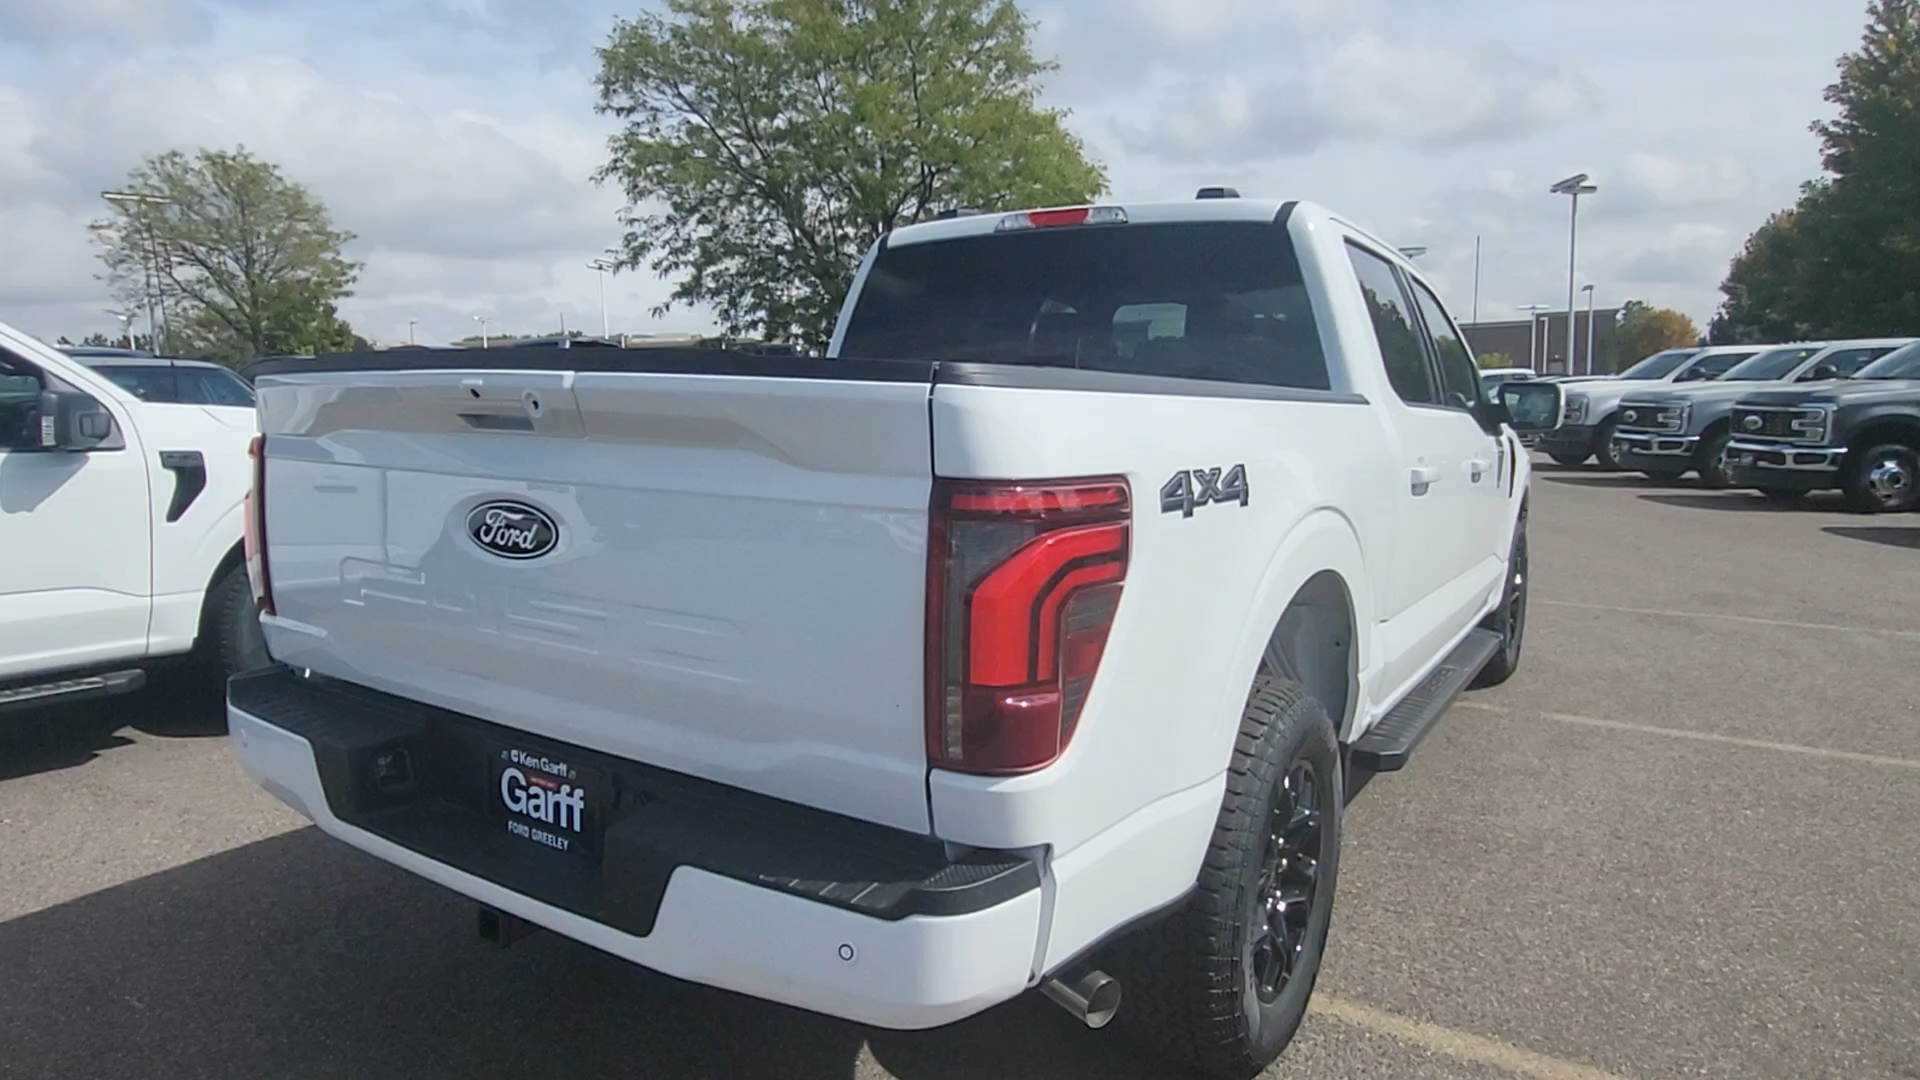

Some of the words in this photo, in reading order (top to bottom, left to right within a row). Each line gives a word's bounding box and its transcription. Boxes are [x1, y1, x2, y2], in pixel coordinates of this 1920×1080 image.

[479, 508, 540, 549] Ford
[540, 757, 567, 777] Garff
[501, 767, 584, 832] Garff
[508, 820, 530, 838] FORD
[531, 828, 569, 851] GREELEY
